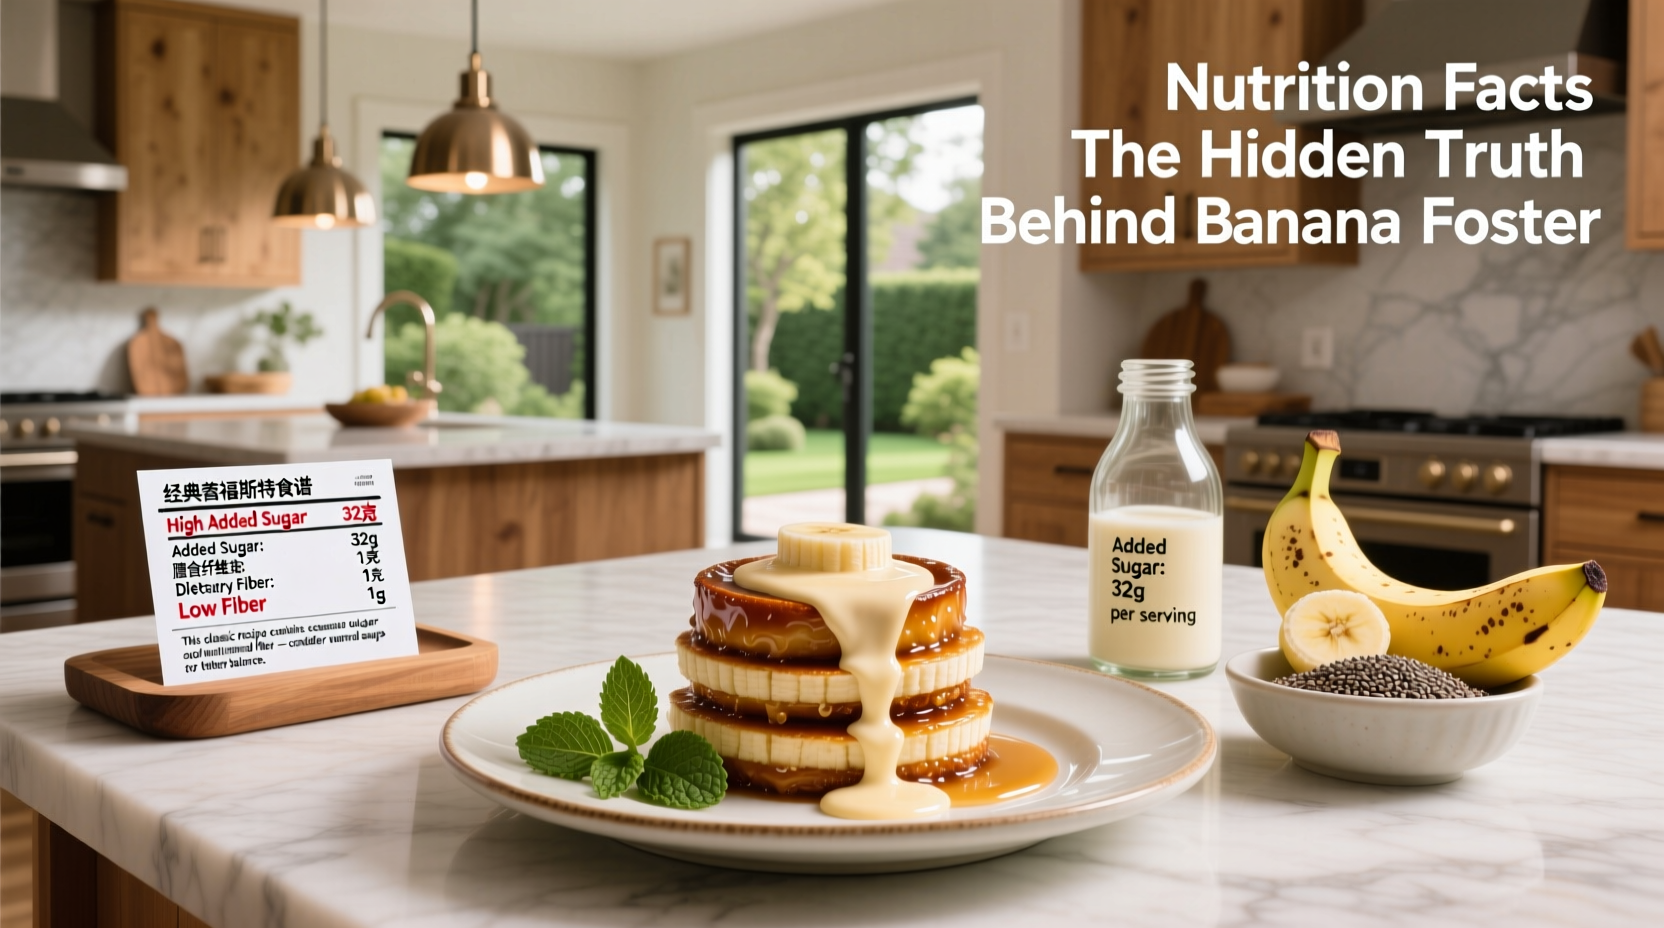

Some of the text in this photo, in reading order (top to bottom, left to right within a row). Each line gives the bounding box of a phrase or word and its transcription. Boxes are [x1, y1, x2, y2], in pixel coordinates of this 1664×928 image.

[167, 515, 204, 536] High
[208, 510, 258, 531] Added
[261, 511, 308, 530] Sugar
[172, 532, 378, 558] Added Sugar: 32g
[1112, 536, 1167, 555] Added
[1111, 557, 1165, 579] Sugar:
[178, 602, 217, 619] Low
[367, 586, 386, 605] 1g
[1111, 579, 1145, 603] 32g
[1111, 607, 1196, 626] per serving
